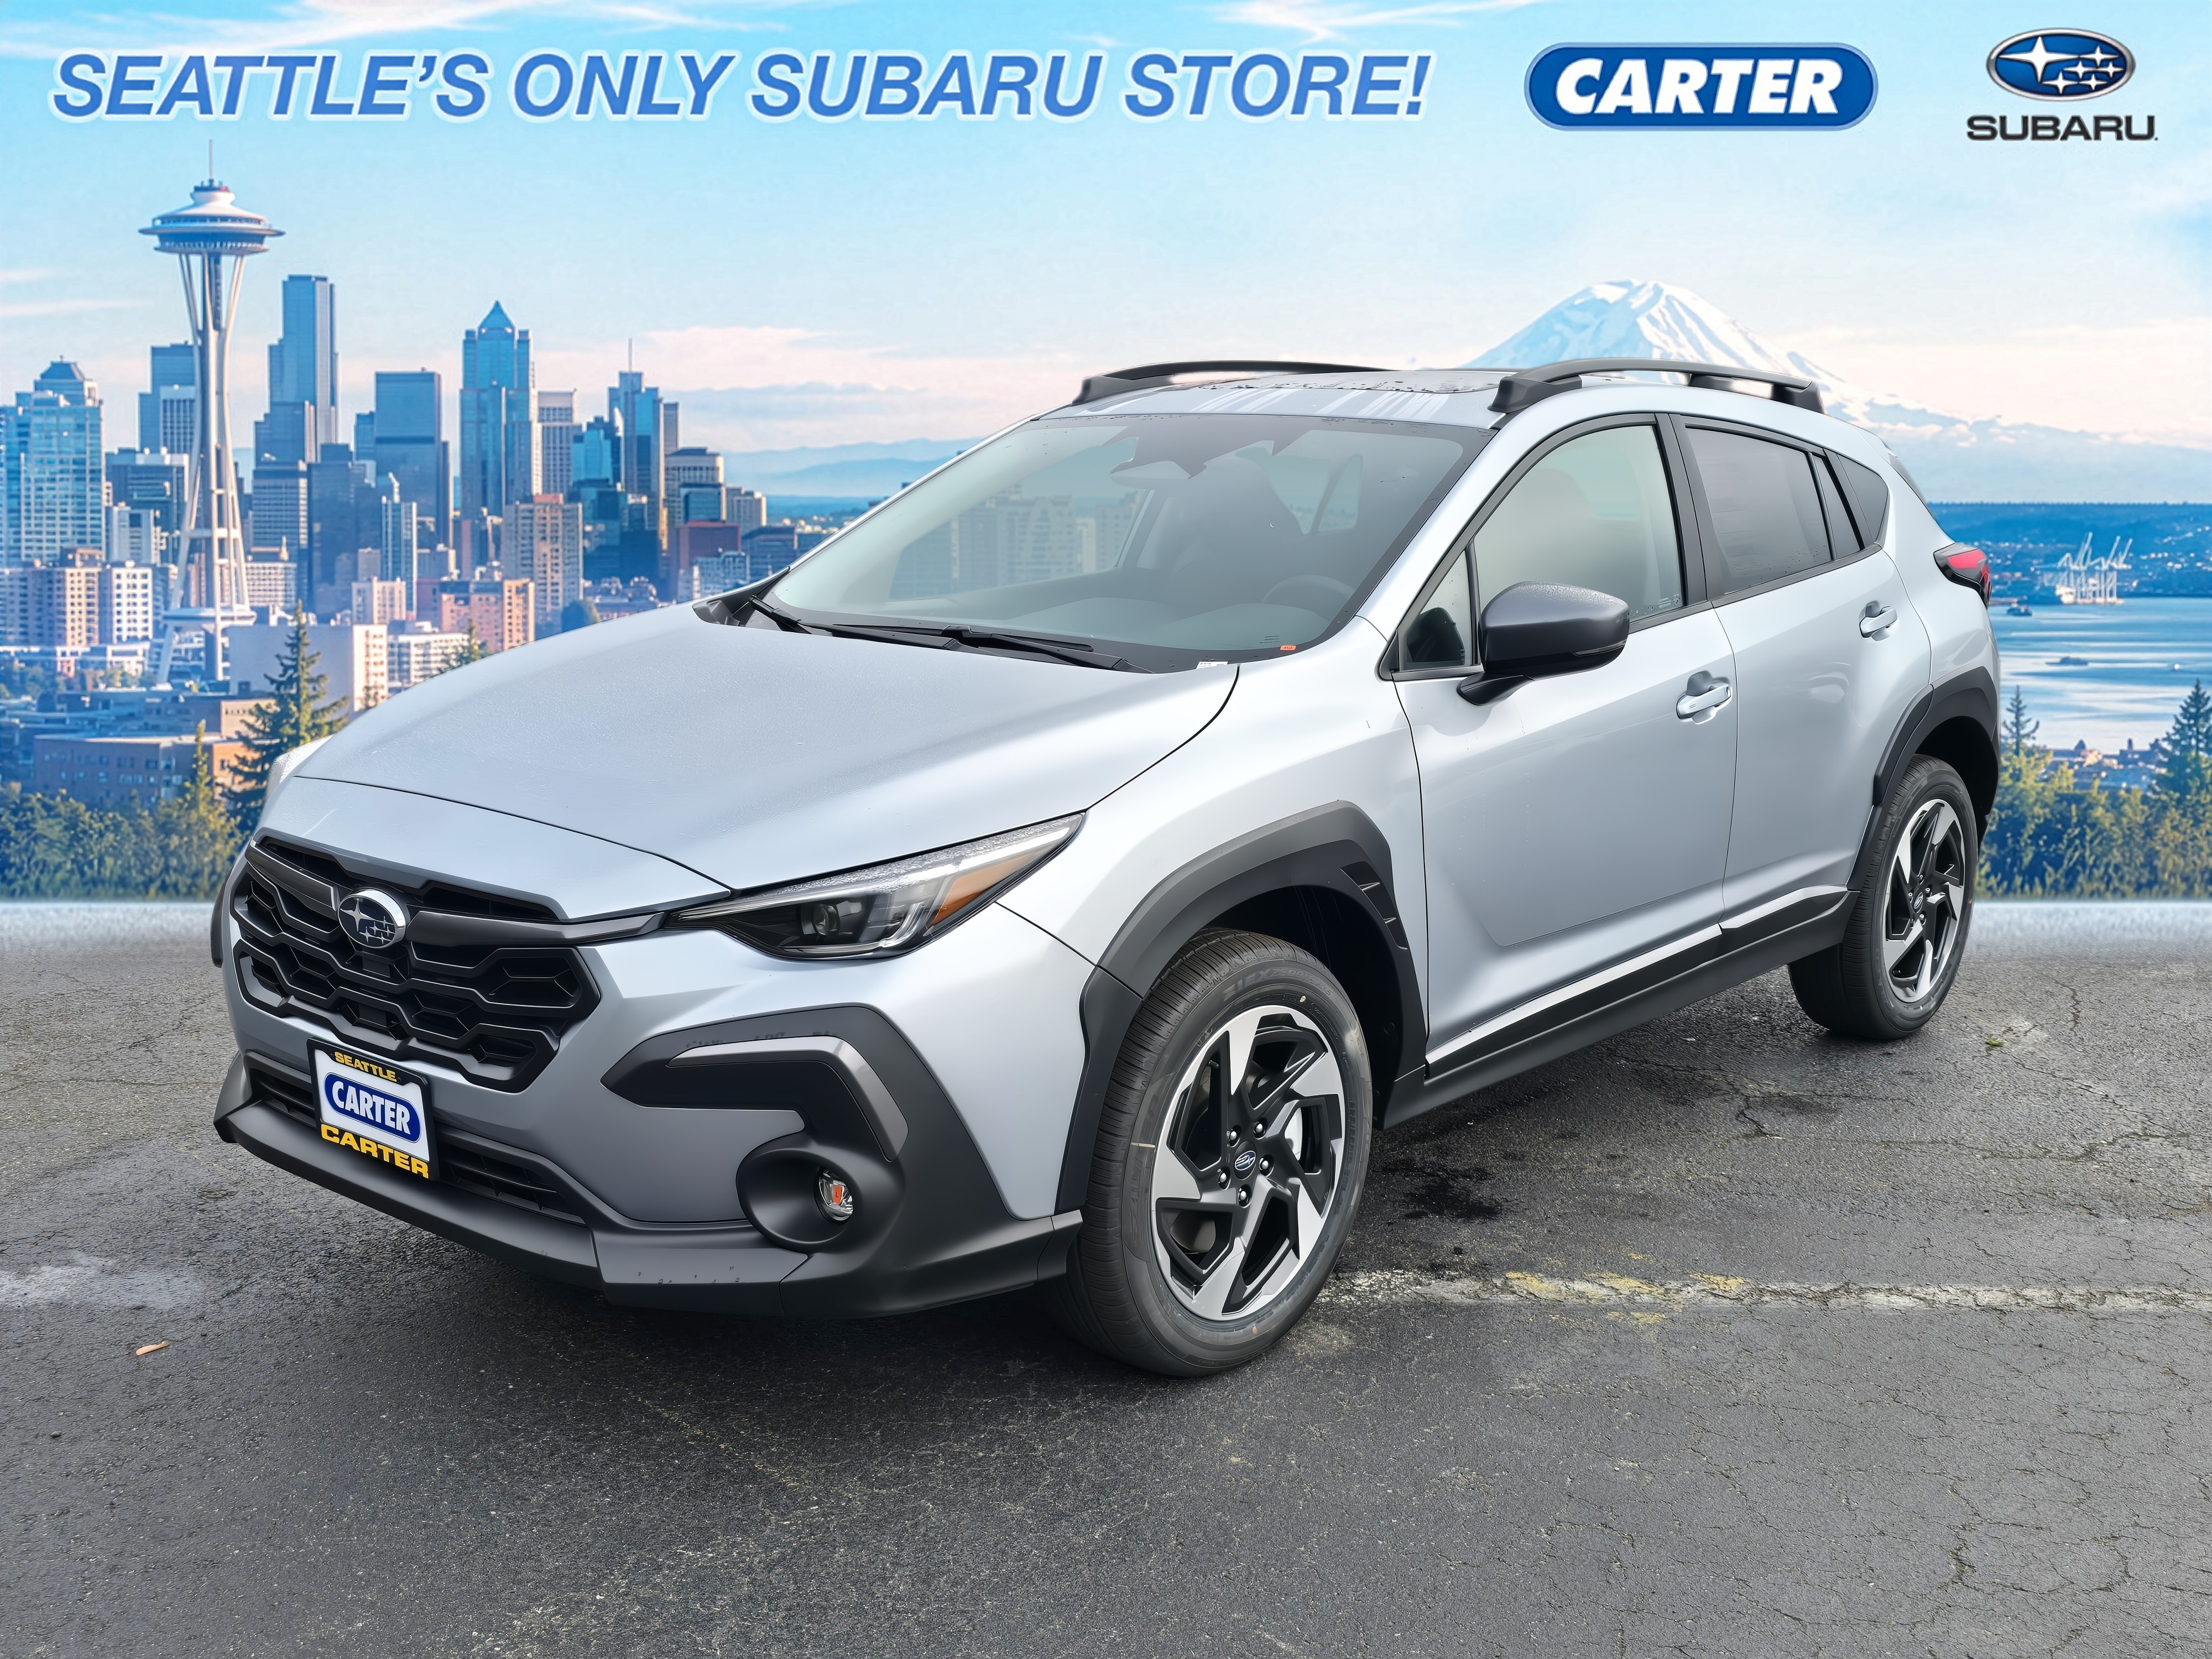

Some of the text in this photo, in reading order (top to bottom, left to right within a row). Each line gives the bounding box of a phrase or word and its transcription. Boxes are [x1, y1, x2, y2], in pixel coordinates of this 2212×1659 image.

[334, 1052, 397, 1082] SEATTLE
[332, 1081, 411, 1135] CARTER
[321, 1124, 429, 1179] CARTER
